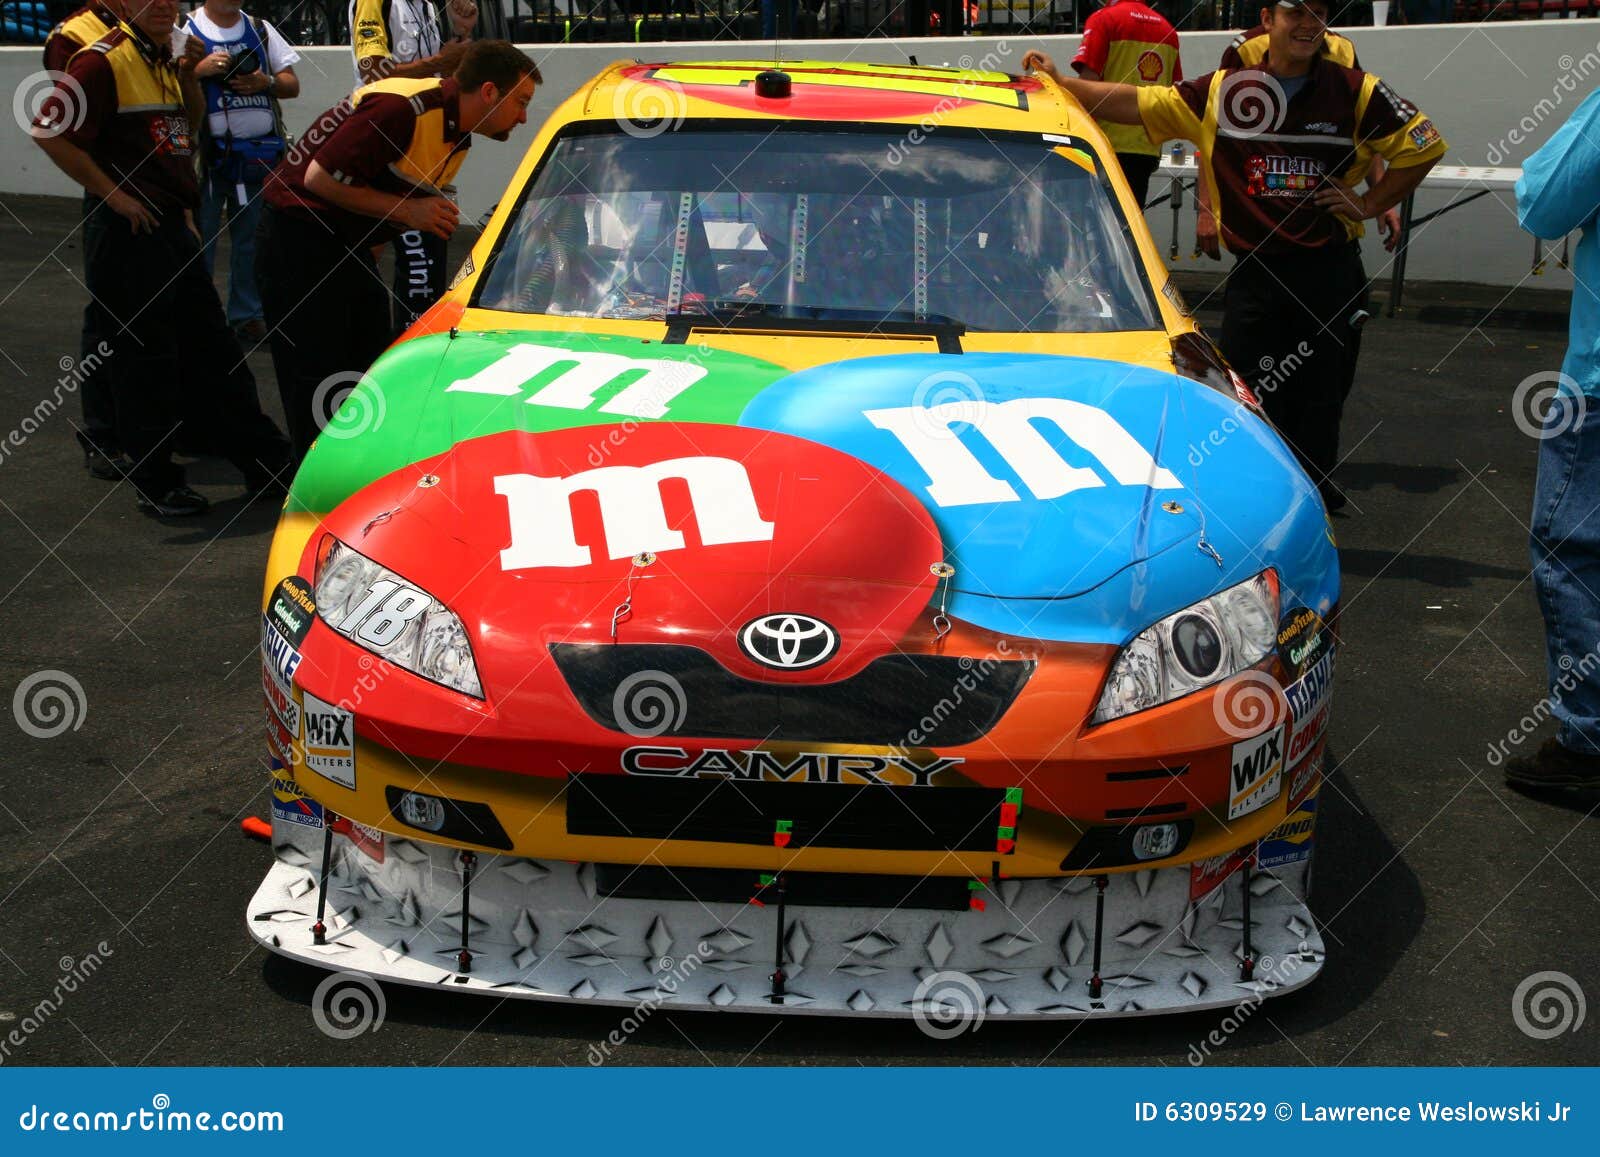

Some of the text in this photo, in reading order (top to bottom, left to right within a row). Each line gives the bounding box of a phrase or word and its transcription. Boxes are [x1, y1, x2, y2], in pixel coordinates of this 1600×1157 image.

[216, 95, 269, 108] Canon
[446, 342, 709, 420] m
[863, 397, 1184, 508] m
[493, 456, 775, 572] m
[337, 578, 433, 647] 18
[305, 711, 350, 746] WIX
[307, 756, 352, 767] FILTERS
[1233, 726, 1281, 792] WIX
[620, 745, 966, 787] CAMRY
